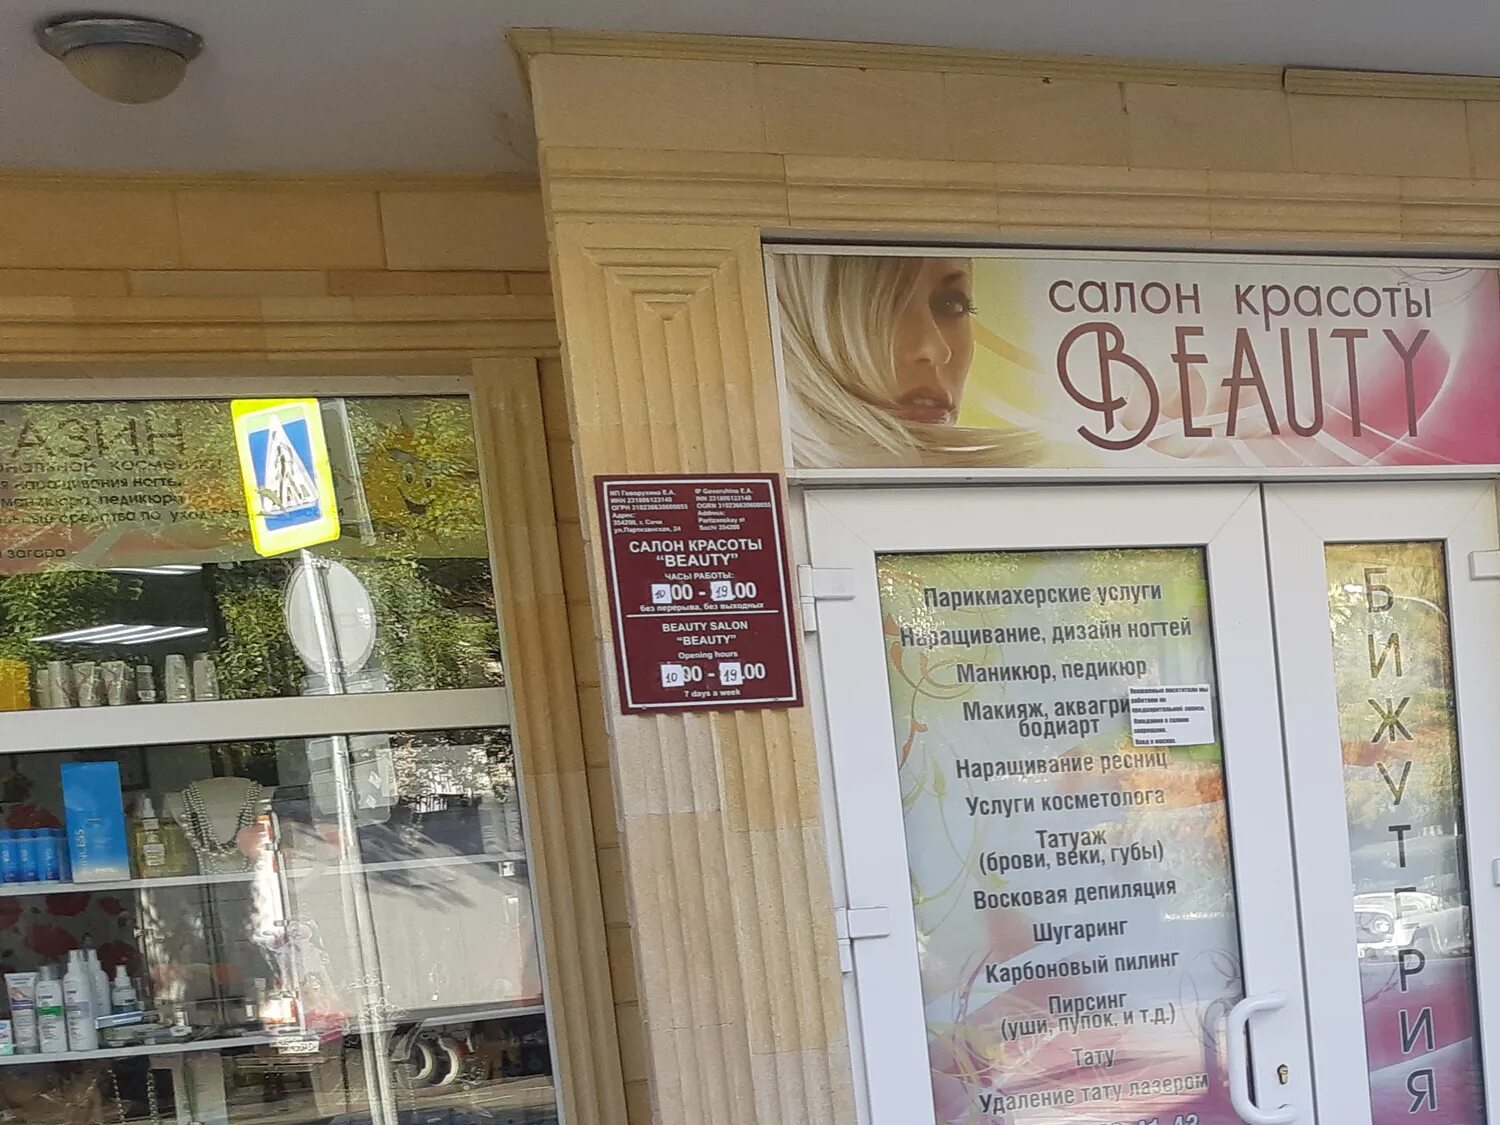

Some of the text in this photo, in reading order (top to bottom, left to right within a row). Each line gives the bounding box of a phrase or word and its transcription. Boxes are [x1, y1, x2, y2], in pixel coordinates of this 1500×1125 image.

[1049, 280, 1431, 332] салон красоты
[1057, 321, 1431, 451] BEAUTY
[0, 417, 185, 457] АЗИН
[132, 478, 182, 489] ногте
[629, 539, 762, 553] САЛОН КРАСОТЫ
[693, 572, 735, 580] РАБОТЫ:
[923, 583, 1162, 612] Парикмахерские услуги
[662, 621, 748, 632] BEAUTY SALON
[900, 617, 1192, 650] Наращивание, дизайн ногтей
[678, 650, 738, 661] Opening hours
[957, 658, 1147, 684] Маникюр, педикюр
[691, 689, 710, 698] days
[720, 688, 741, 697] week
[963, 697, 1130, 722] Макияж, аквагри
[1019, 717, 1100, 739] бодиарт
[956, 752, 1168, 781] Наращивание ресниц
[965, 787, 1165, 818] Услуги косметолога
[1035, 828, 1107, 852] Татуаж
[1363, 567, 1437, 1113] БИЖУТЕРИЯ
[979, 840, 1165, 876] (брови, веки, губы)
[973, 878, 1177, 910] Восковая депиляция
[1033, 920, 1129, 945] Шугаринг
[985, 952, 1181, 984] Карбоновый пилинг
[1048, 993, 1127, 1016] Пирсинг
[1001, 1017, 1053, 1041] (уши,
[1123, 1012, 1133, 1025] и
[1139, 1003, 1176, 1025] т.д.)
[1072, 1047, 1115, 1068] Тату
[978, 1073, 1209, 1114] Удаление тату лазером
